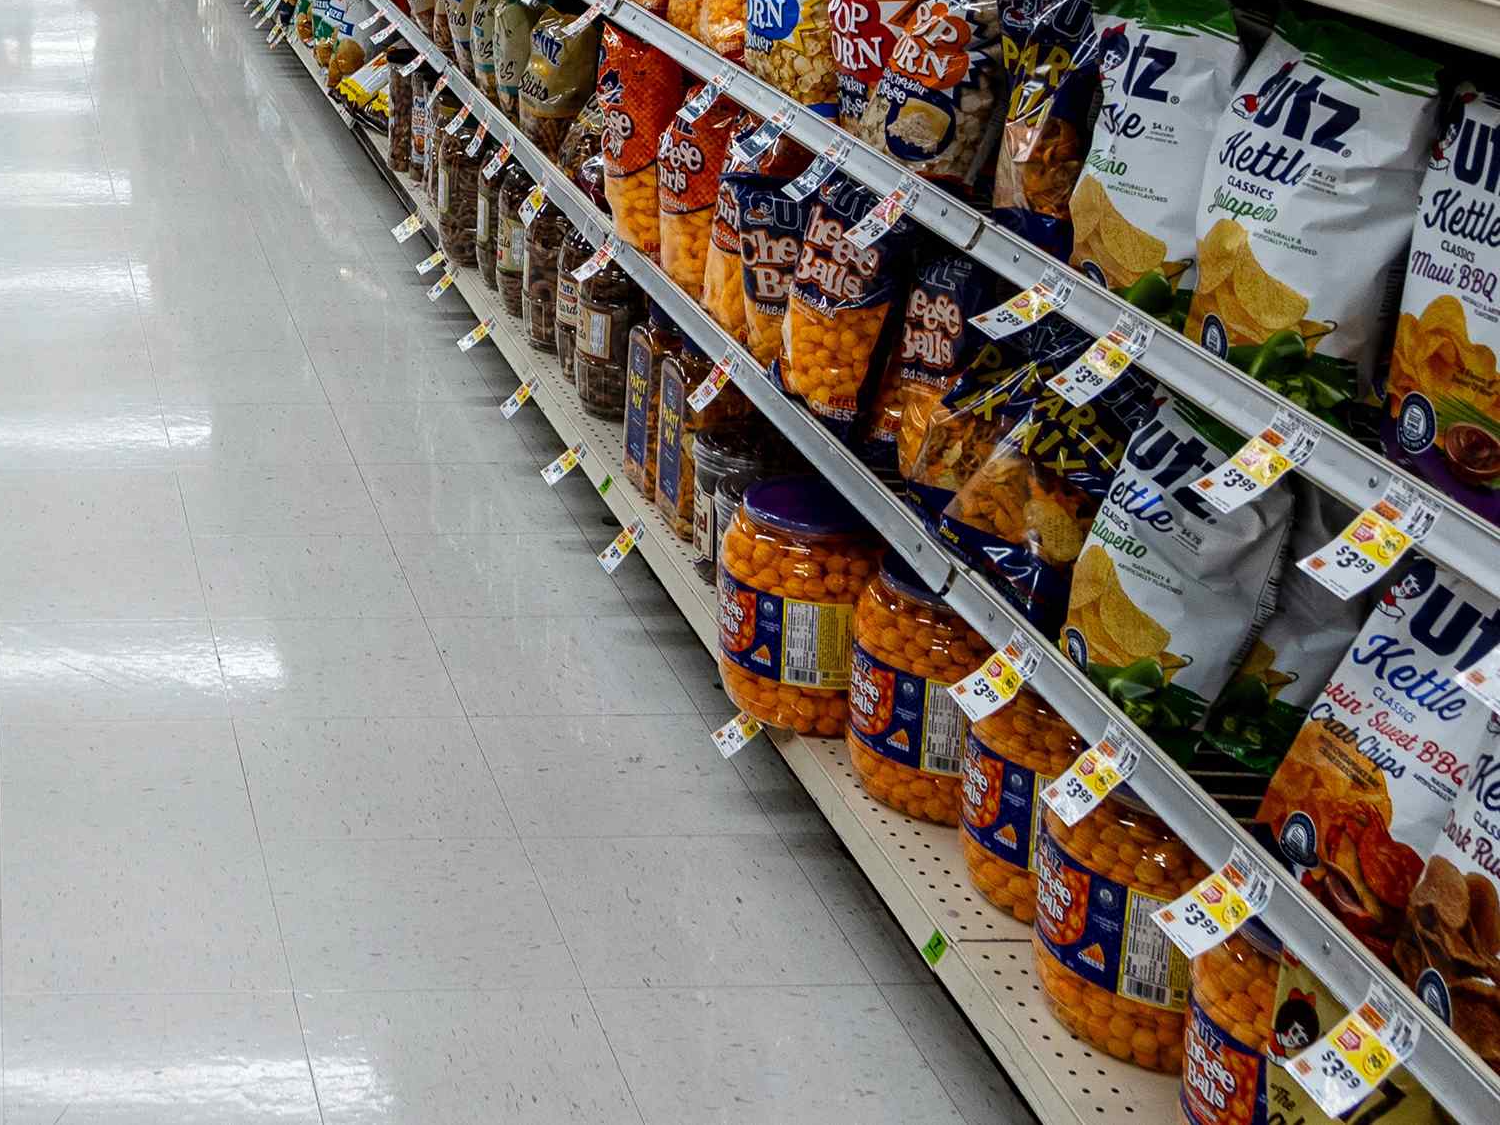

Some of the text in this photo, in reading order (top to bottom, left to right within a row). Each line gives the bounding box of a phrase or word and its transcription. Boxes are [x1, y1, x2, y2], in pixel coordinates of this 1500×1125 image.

[831, 35, 883, 73] ORN
[894, 35, 950, 81] ORN
[659, 168, 687, 193] urls
[1227, 175, 1275, 202] CLASSICS
[806, 204, 878, 274] heese
[1423, 186, 1500, 248] Kettle
[1440, 240, 1477, 264] CLASSICS
[1411, 250, 1499, 303] Maui BBQ
[1109, 476, 1174, 533] ettle
[1092, 520, 1148, 559] alapeño
[1352, 634, 1467, 722] Kettle
[1372, 686, 1417, 724] CLASSICS
[1309, 700, 1360, 746] Crab
[1356, 735, 1408, 780] Chips
[1367, 710, 1420, 752] Sweet
